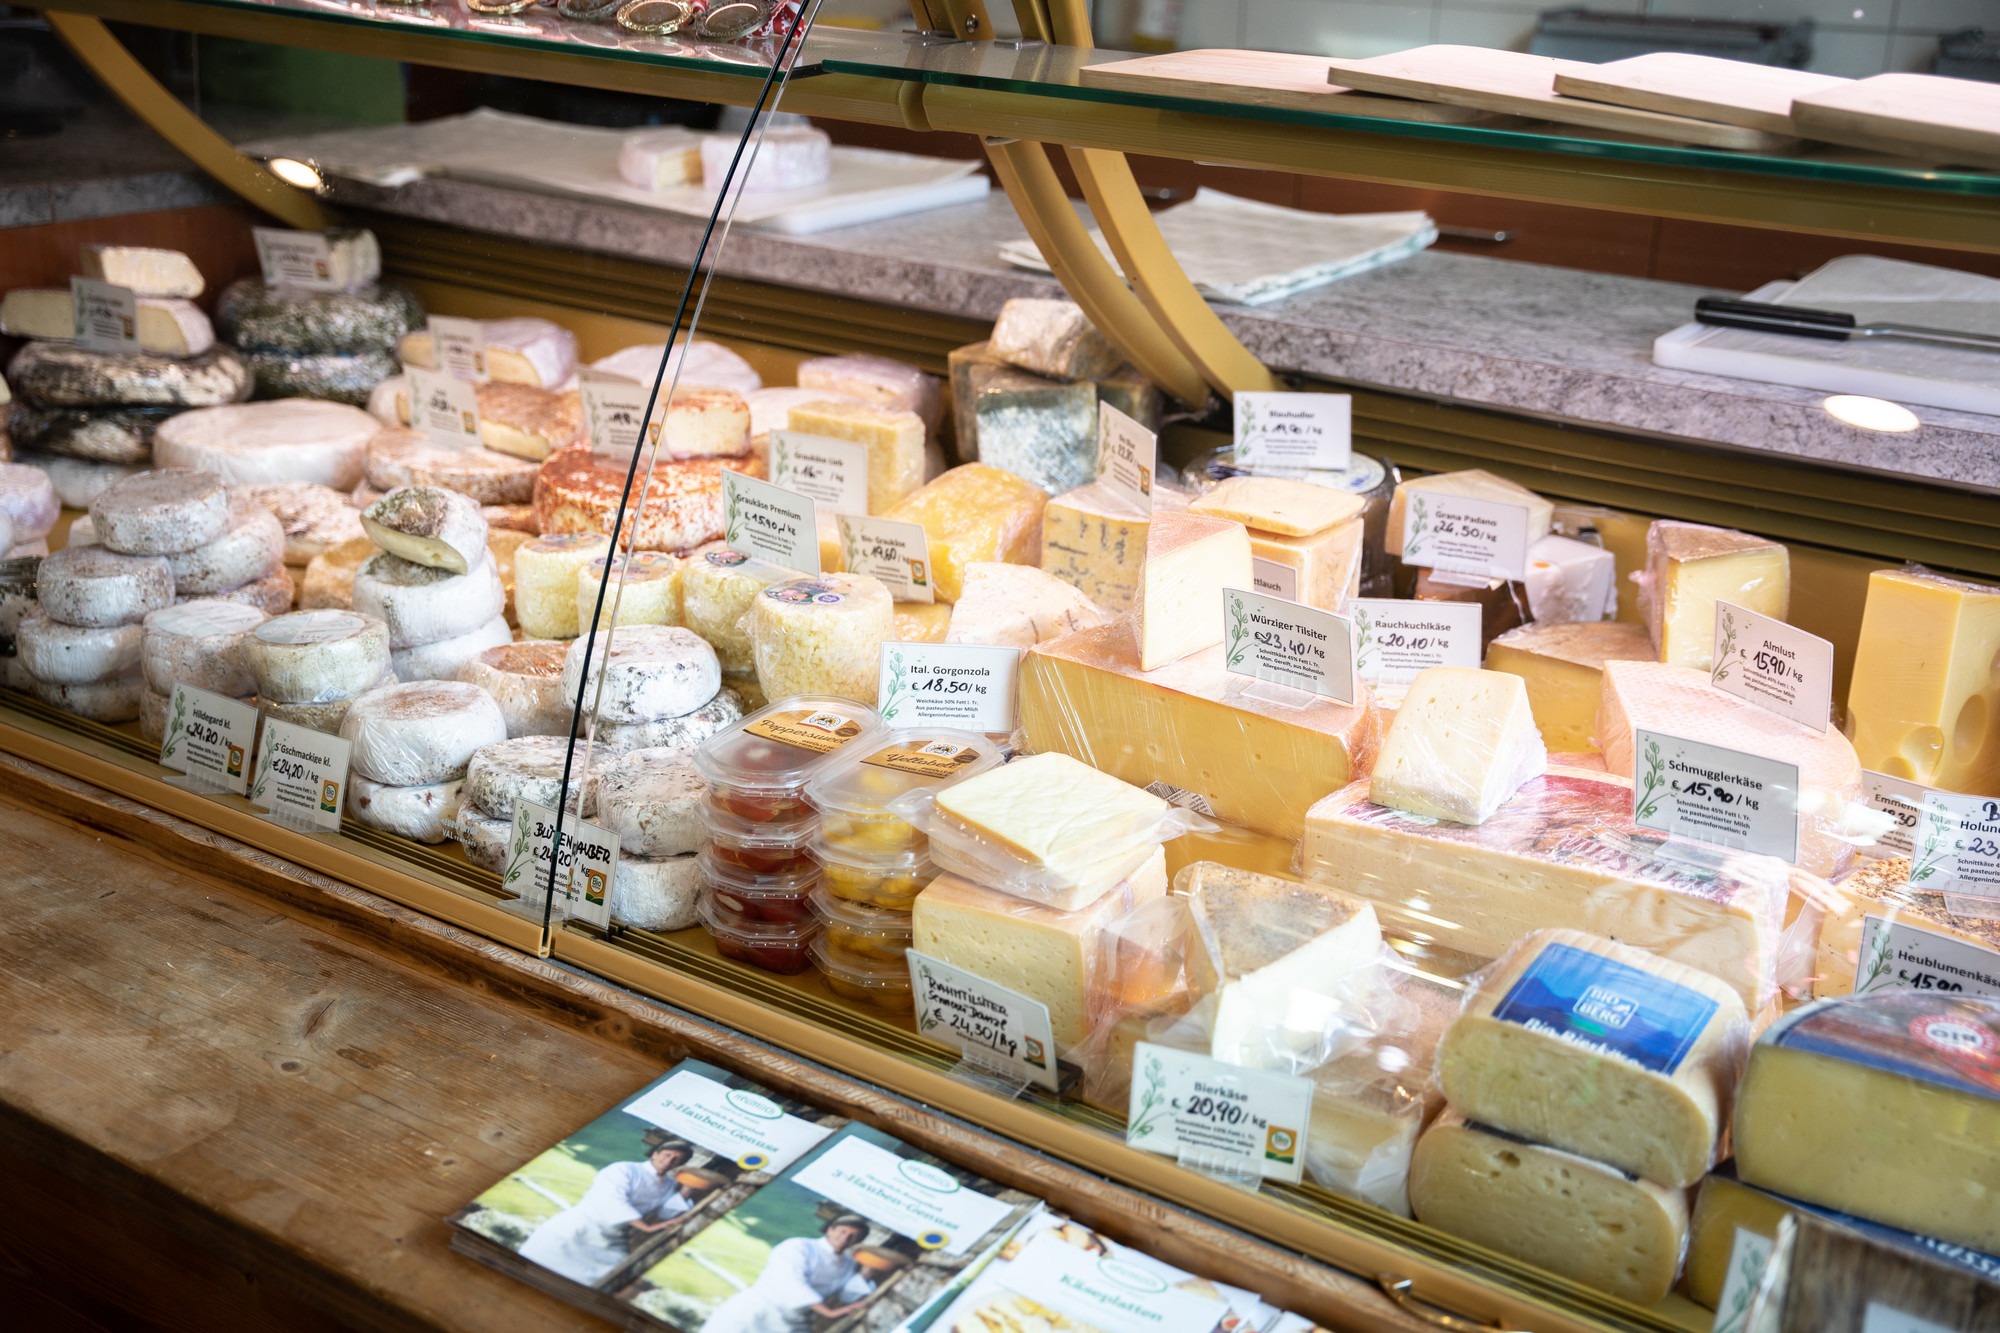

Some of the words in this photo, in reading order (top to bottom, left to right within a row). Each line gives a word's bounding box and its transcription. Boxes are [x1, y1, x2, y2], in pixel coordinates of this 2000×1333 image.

[736, 493, 769, 510] Graukäse
[770, 504, 802, 521] Premium
[1435, 511, 1461, 521] Grana
[1464, 514, 1497, 527] Padano
[787, 524, 796, 536] kg
[1486, 533, 1497, 543] kg
[1250, 613, 1293, 631] Würziger
[1295, 624, 1327, 641] Tilsiter
[1375, 620, 1451, 631] Rauchkuchlkäse
[1437, 638, 1449, 648] kg
[1763, 640, 1796, 660] Almlust
[1259, 648, 1287, 660] Schnittkäse
[1314, 646, 1325, 659] kg
[910, 665, 930, 674] Ital.
[932, 665, 990, 677] Gorgonzola
[1262, 663, 1312, 680] Allergeninformation:
[1302, 665, 1325, 676] Rohmilch
[1740, 648, 1747, 658] €
[1753, 651, 1785, 676] 15,90
[1793, 669, 1803, 683] kg
[911, 682, 918, 691] €
[975, 684, 987, 695] kg
[192, 708, 223, 726] Hildegard
[225, 738, 232, 750] kg
[323, 756, 331, 767] kl.
[311, 772, 319, 784] kg
[1669, 760, 1763, 790] Schmugglerkäse
[1672, 780, 1679, 789] €
[1683, 781, 1734, 803] 15,90
[1745, 796, 1759, 811] kg
[1676, 799, 1710, 811] Schnittkäse
[1711, 807, 1724, 815] 45%
[1680, 815, 1741, 834] Allergeninformation:
[1689, 810, 1732, 824] pasteurisierter
[1733, 820, 1751, 829] Milch
[1960, 820, 2000, 834] Holun
[534, 822, 611, 864] BLÜENAUBER
[1955, 839, 1965, 849] €
[533, 847, 538, 856] €
[540, 845, 571, 867] 2420
[580, 864, 589, 877] kg
[1957, 858, 1995, 868] Schnittkäse
[592, 877, 602, 887] Bio
[1900, 970, 1907, 980] €
[1910, 972, 1963, 992] 1590
[1590, 988, 1619, 1005] BIO
[932, 1008, 945, 1022] €
[1579, 1002, 1622, 1026] BERG
[1194, 1081, 1249, 1102] Bierkäse
[1186, 1095, 1241, 1125] 20,90
[1252, 1114, 1267, 1130] kg
[1274, 1132, 1290, 1145] Bio
[1060, 1273, 1163, 1322] Käseplatten
